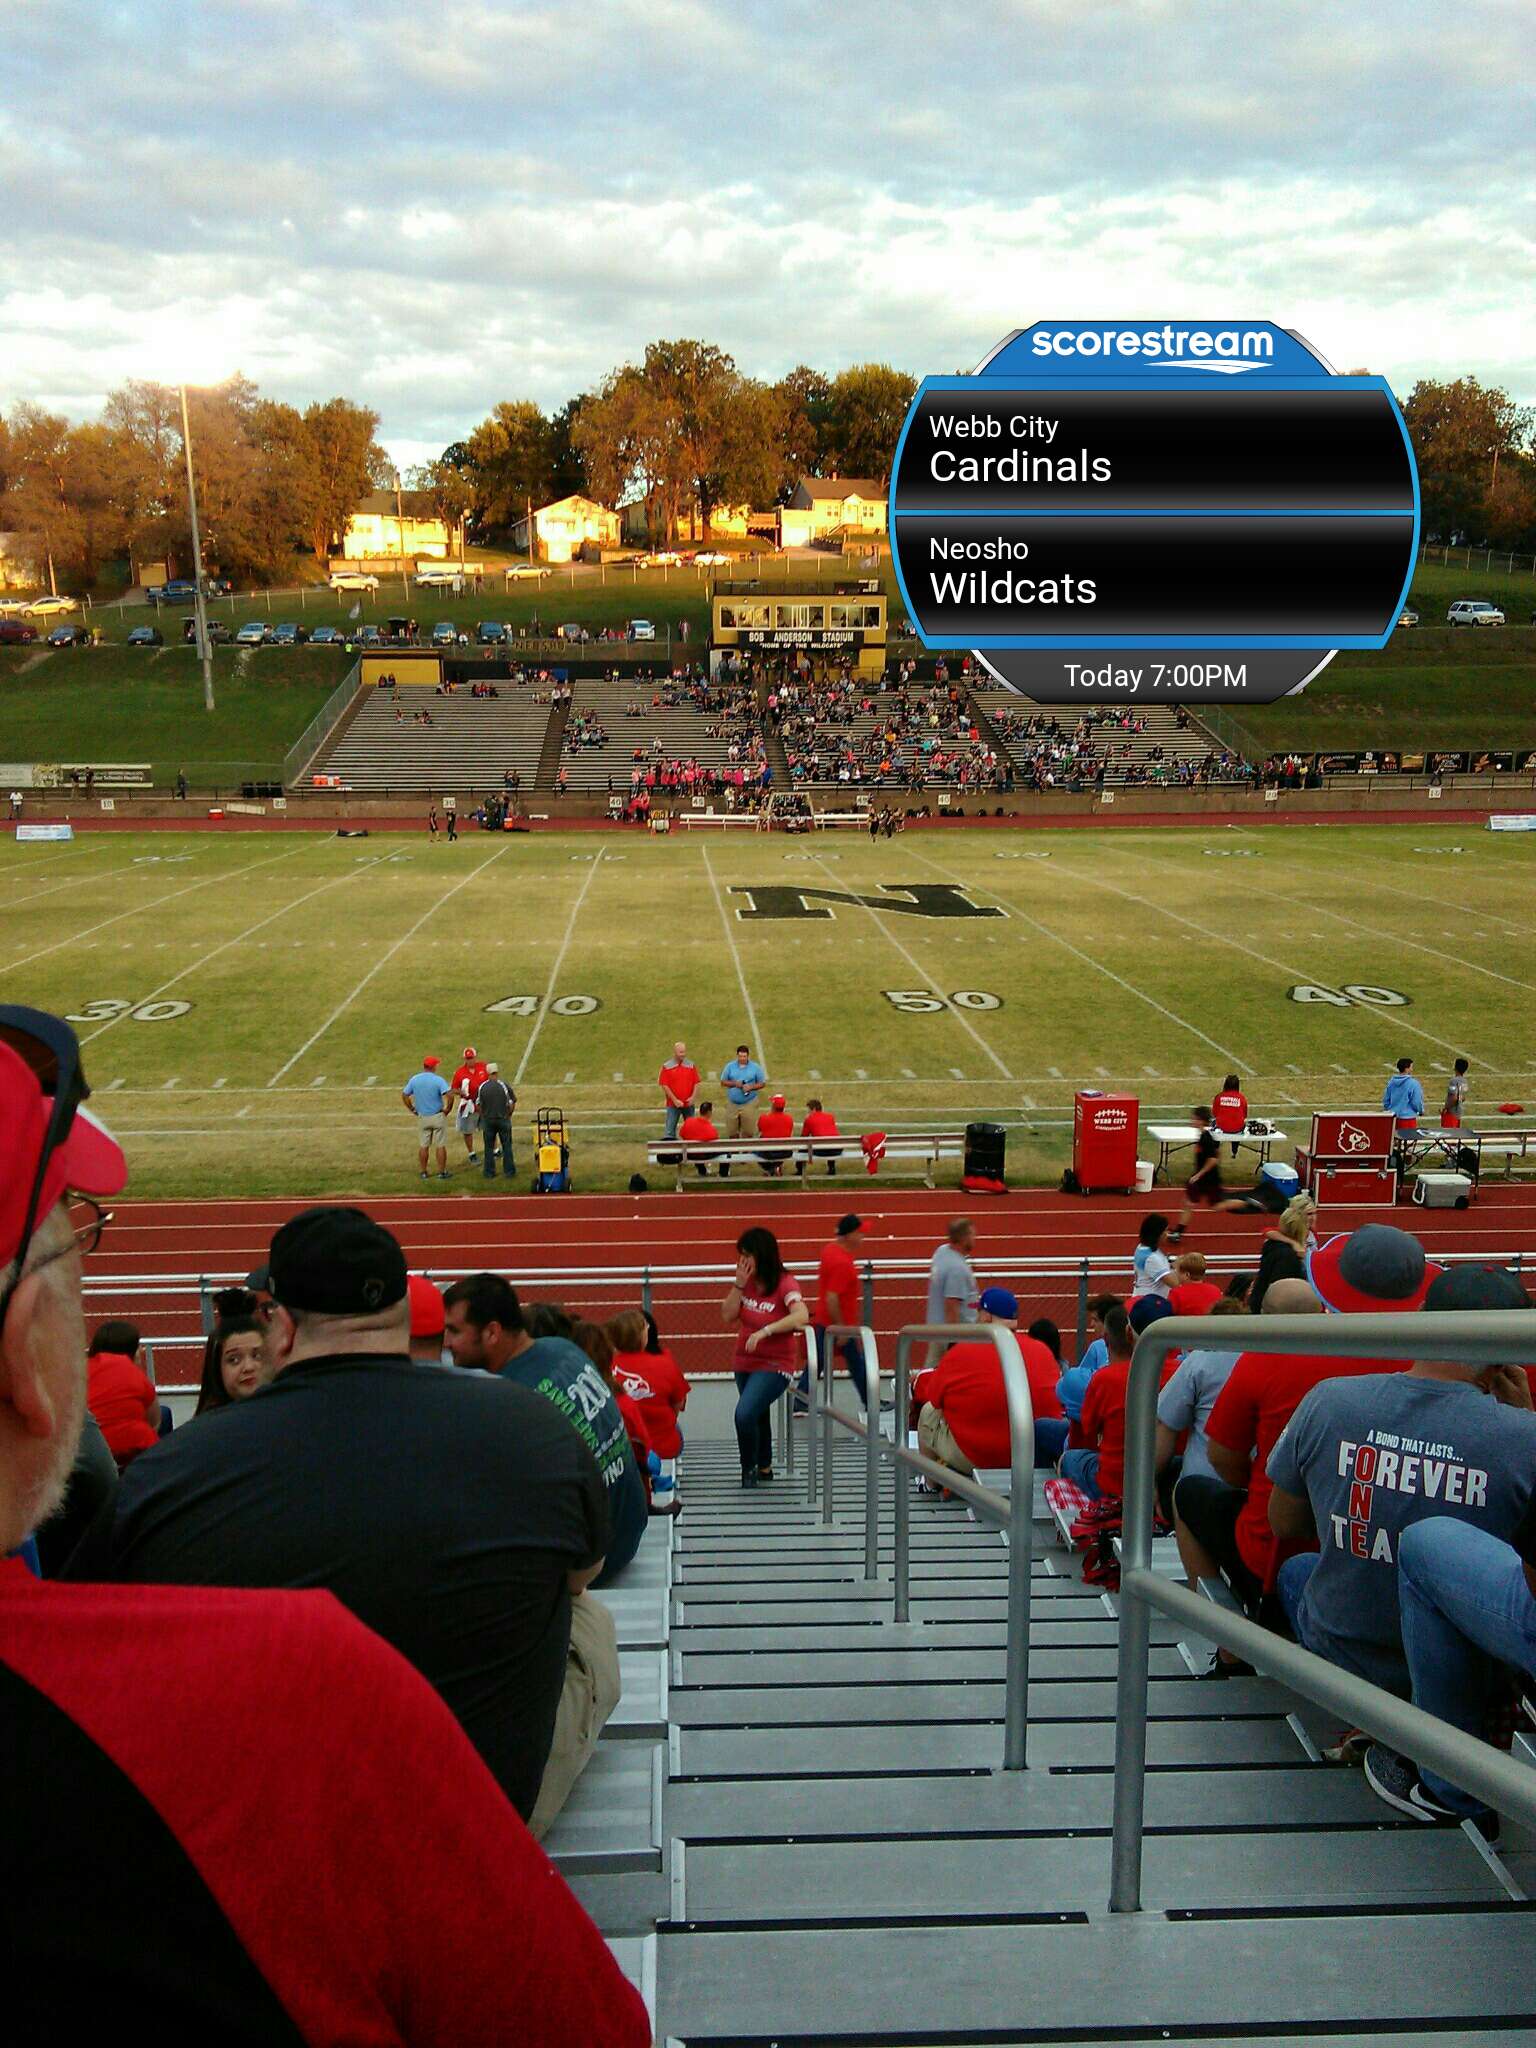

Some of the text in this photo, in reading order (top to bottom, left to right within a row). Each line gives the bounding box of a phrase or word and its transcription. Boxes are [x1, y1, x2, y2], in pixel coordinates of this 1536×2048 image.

[748, 631, 854, 642] BOB ANDERSON STADIUM
[482, 995, 602, 1017] 40
[881, 990, 1003, 1014] 50
[1287, 985, 1410, 1008] 40
[64, 999, 192, 1022] 30
[1366, 1429, 1375, 1442] A
[1375, 1431, 1400, 1449] BOND
[1401, 1437, 1425, 1454] THAT
[1337, 1440, 1489, 1508] FOREVER
[1330, 1514, 1403, 1564] TEA
